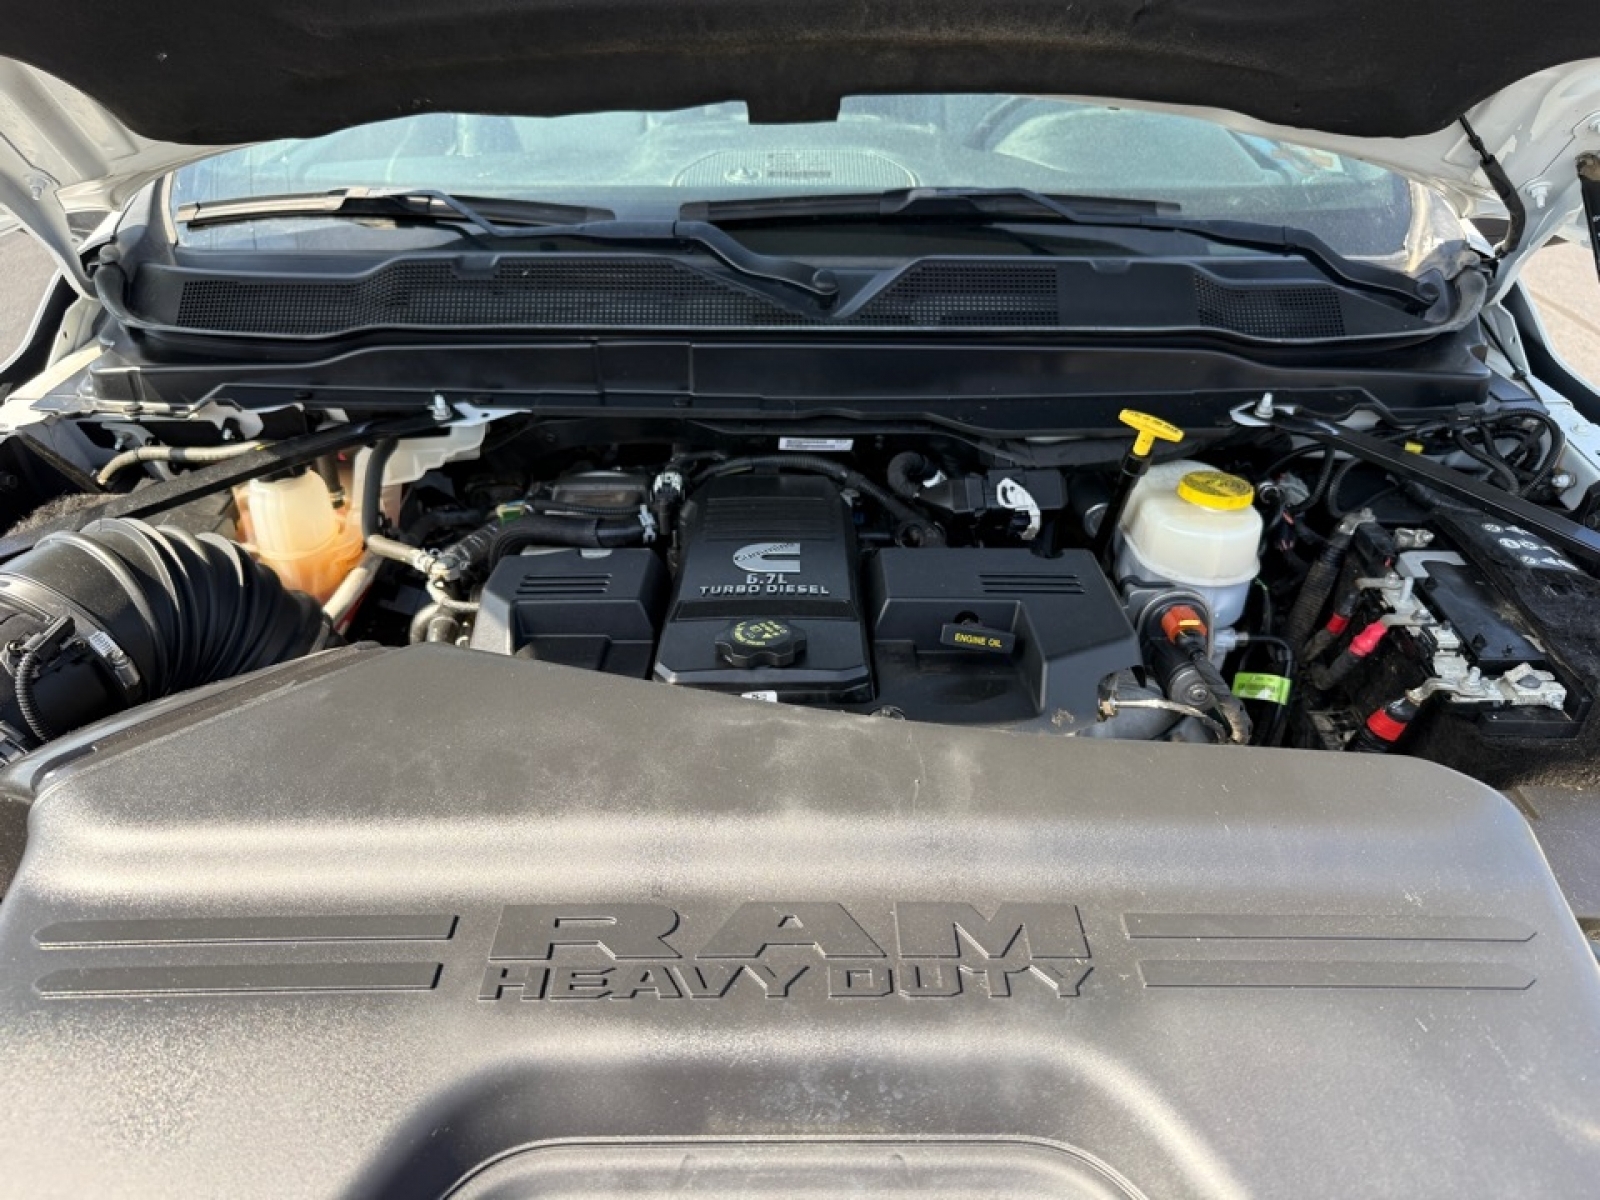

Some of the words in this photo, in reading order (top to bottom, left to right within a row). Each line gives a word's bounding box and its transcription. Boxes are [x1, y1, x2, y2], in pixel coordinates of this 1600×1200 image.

[746, 573, 788, 585] 6.7L
[699, 585, 761, 595] TURBO
[766, 585, 830, 595] DIESEL
[955, 632, 985, 646] ENGINE
[988, 637, 1002, 648] OIL
[488, 902, 1093, 961] RAM
[478, 964, 811, 1001] HEAVY
[828, 964, 1096, 1000] DUTY
